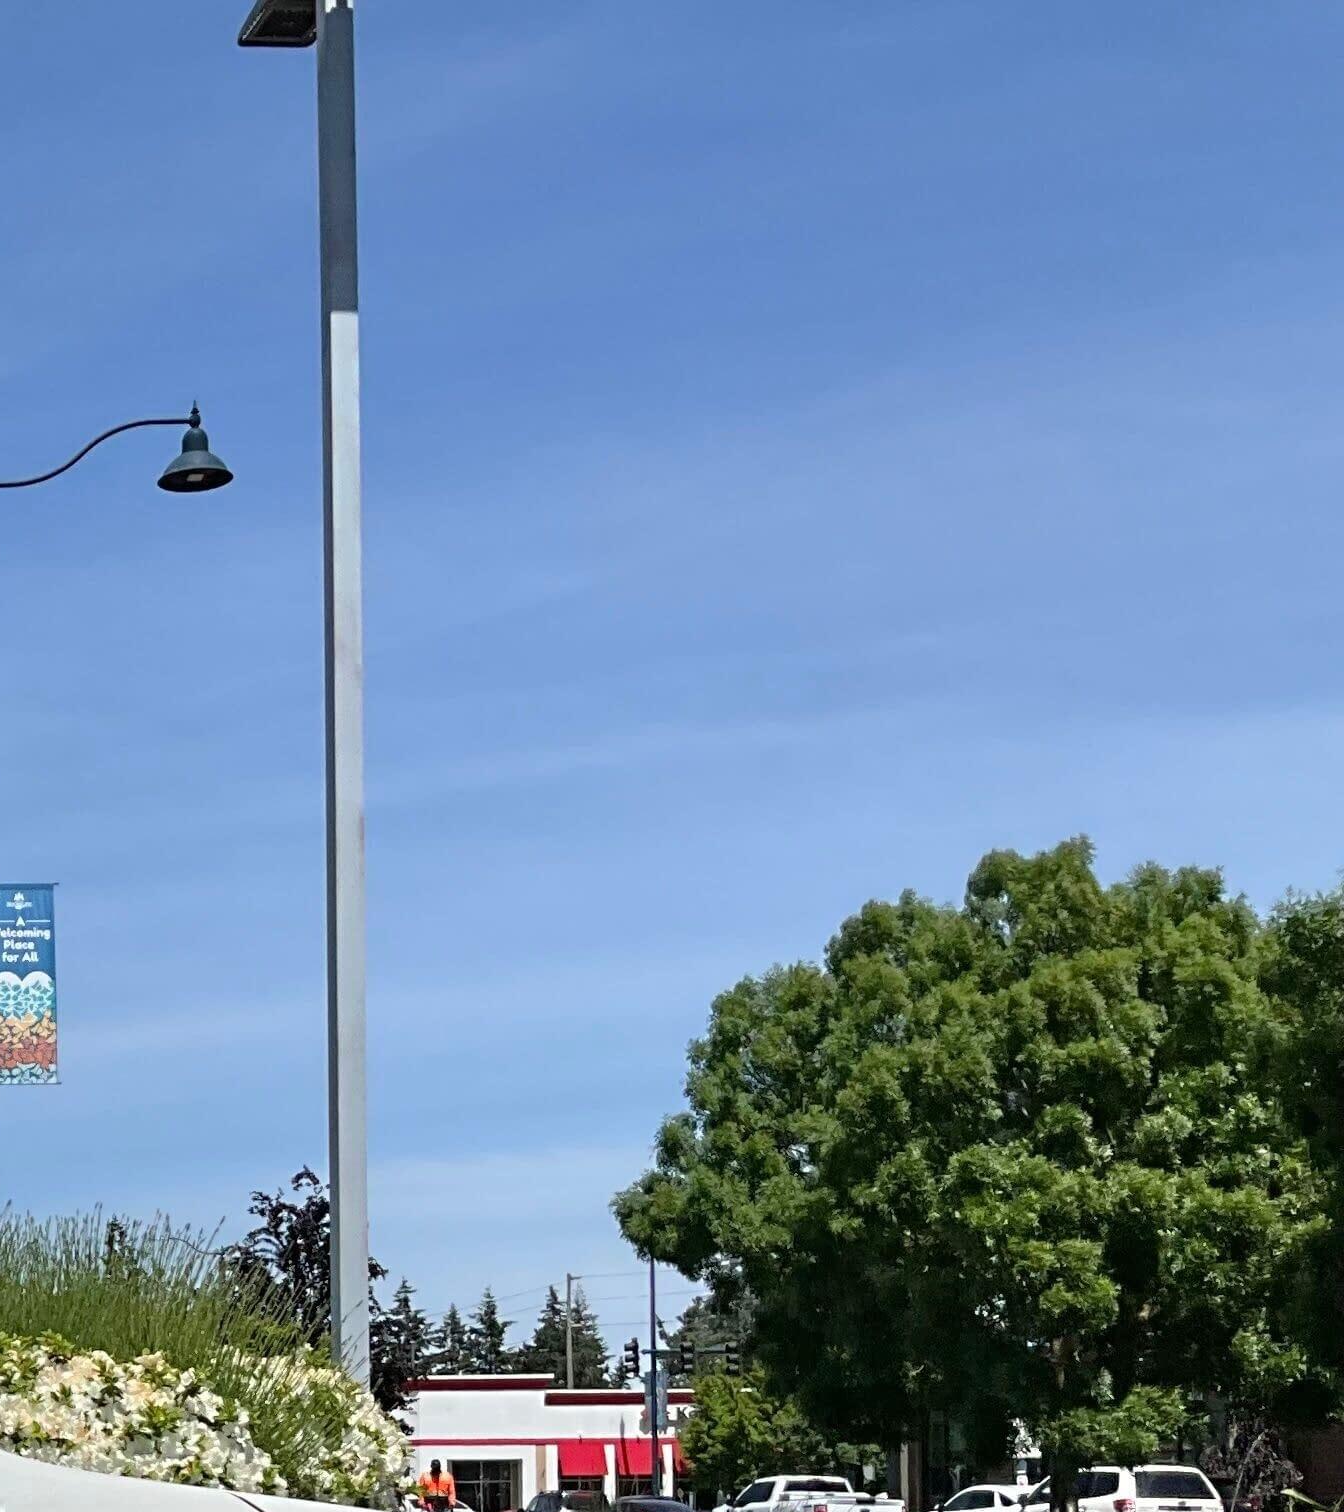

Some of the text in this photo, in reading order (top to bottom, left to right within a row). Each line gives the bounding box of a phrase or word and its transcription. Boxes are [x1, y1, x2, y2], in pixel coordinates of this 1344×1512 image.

[15, 915, 26, 927] A
[3, 940, 35, 950] Place
[1, 951, 40, 963] for All
